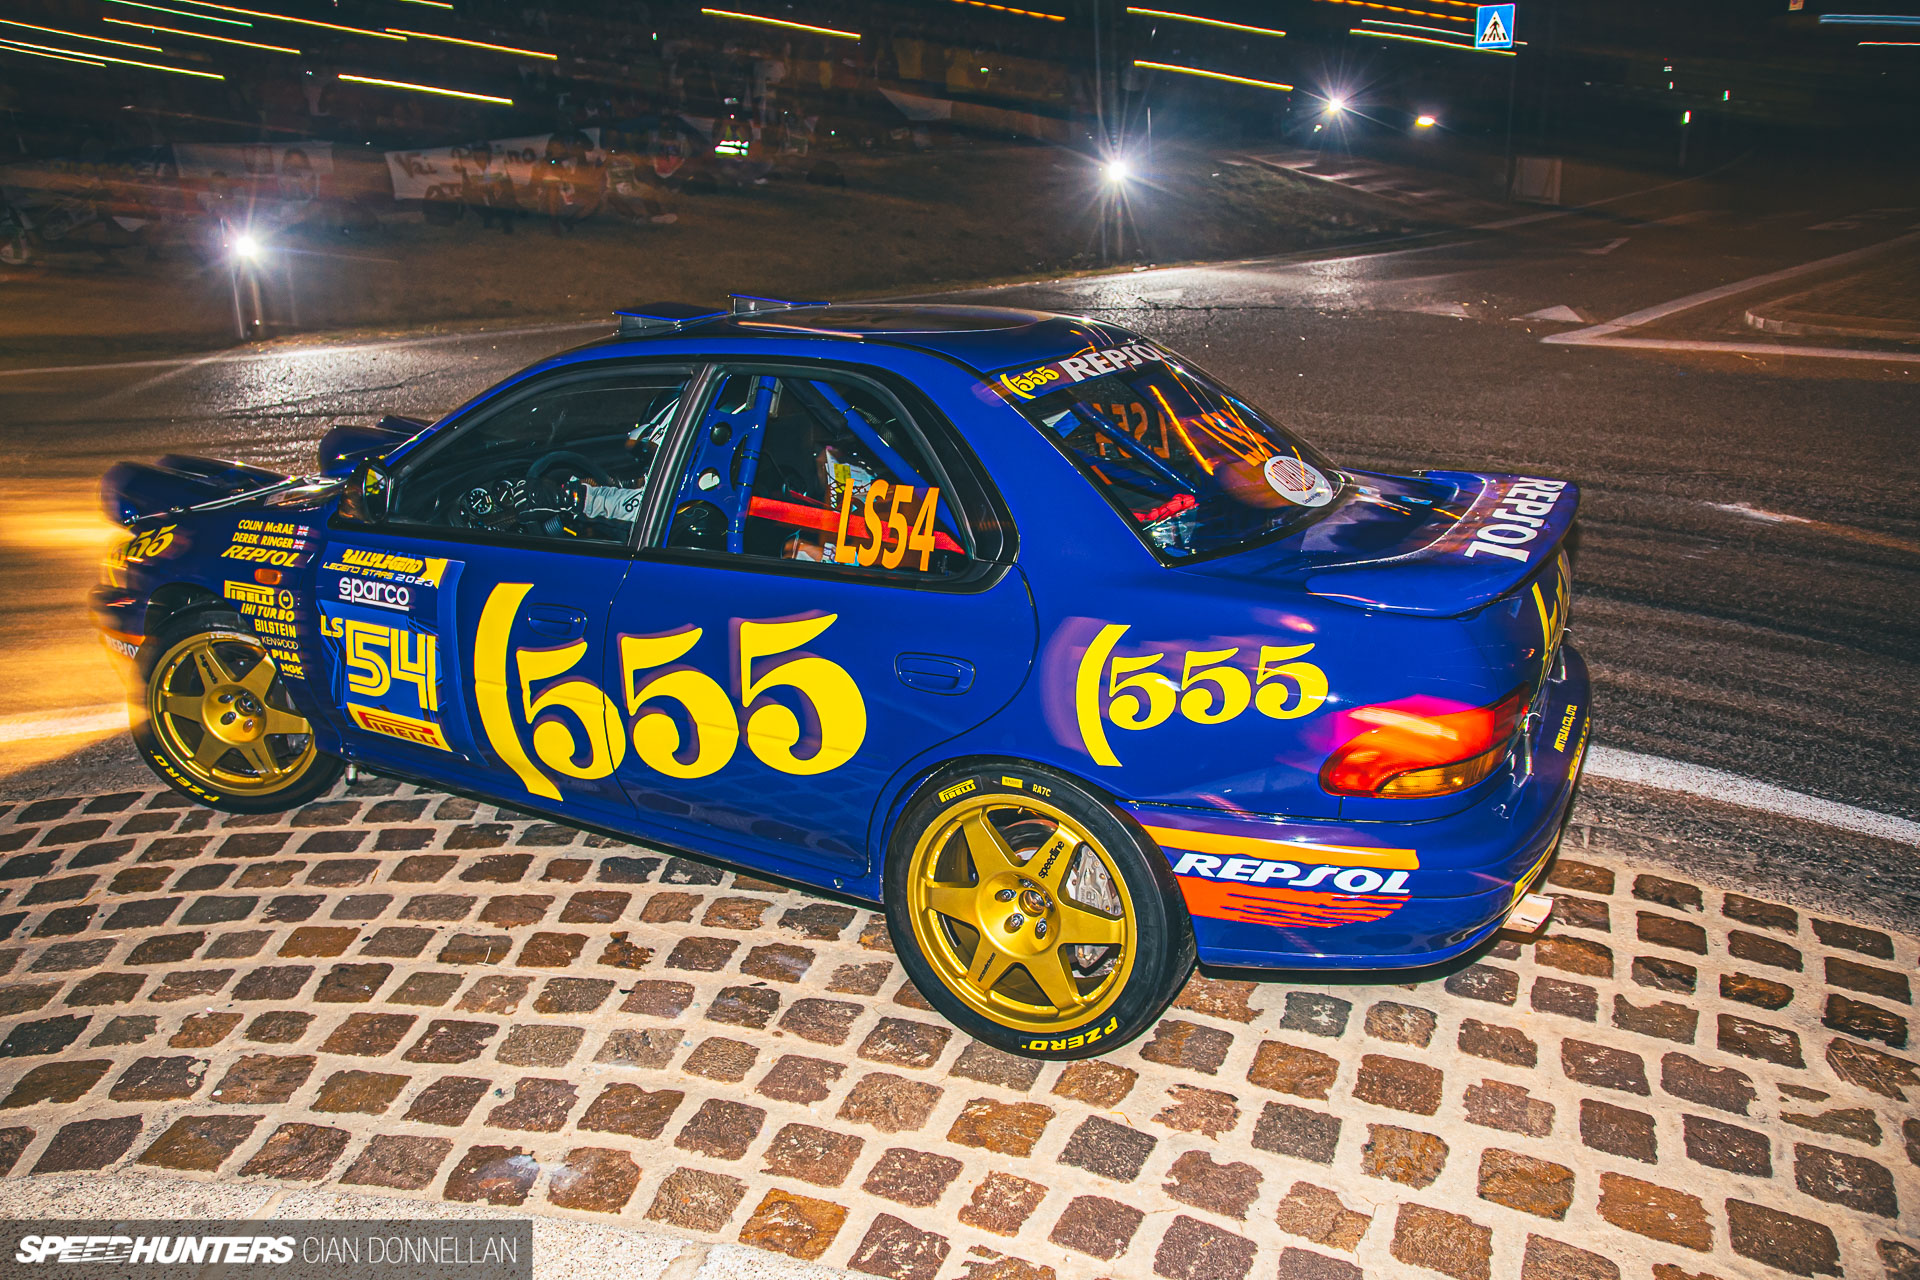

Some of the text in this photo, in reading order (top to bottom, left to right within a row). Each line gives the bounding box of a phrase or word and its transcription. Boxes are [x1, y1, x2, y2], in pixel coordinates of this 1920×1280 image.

[238, 520, 295, 535] COLIN McRAE
[834, 477, 940, 572] LS54
[1464, 477, 1568, 563] REPSOL
[232, 532, 294, 549] DEREK RINGER
[221, 545, 300, 567] REPSOL
[323, 562, 435, 588] LEGEND STARS 2023
[224, 580, 275, 606] PIRELLI
[339, 577, 410, 604] sparco
[241, 603, 295, 622] IHI TURBO
[254, 619, 297, 638] BILSTEIN
[261, 636, 299, 650] KENWOOD
[271, 649, 301, 663] PIAA
[320, 614, 438, 712] LS 54
[280, 663, 304, 676] NGK
[357, 711, 441, 747] PIRELLI
[938, 779, 977, 803] PIRELLI
[1038, 840, 1065, 879] speedline
[1172, 853, 1411, 894] REPSOL
